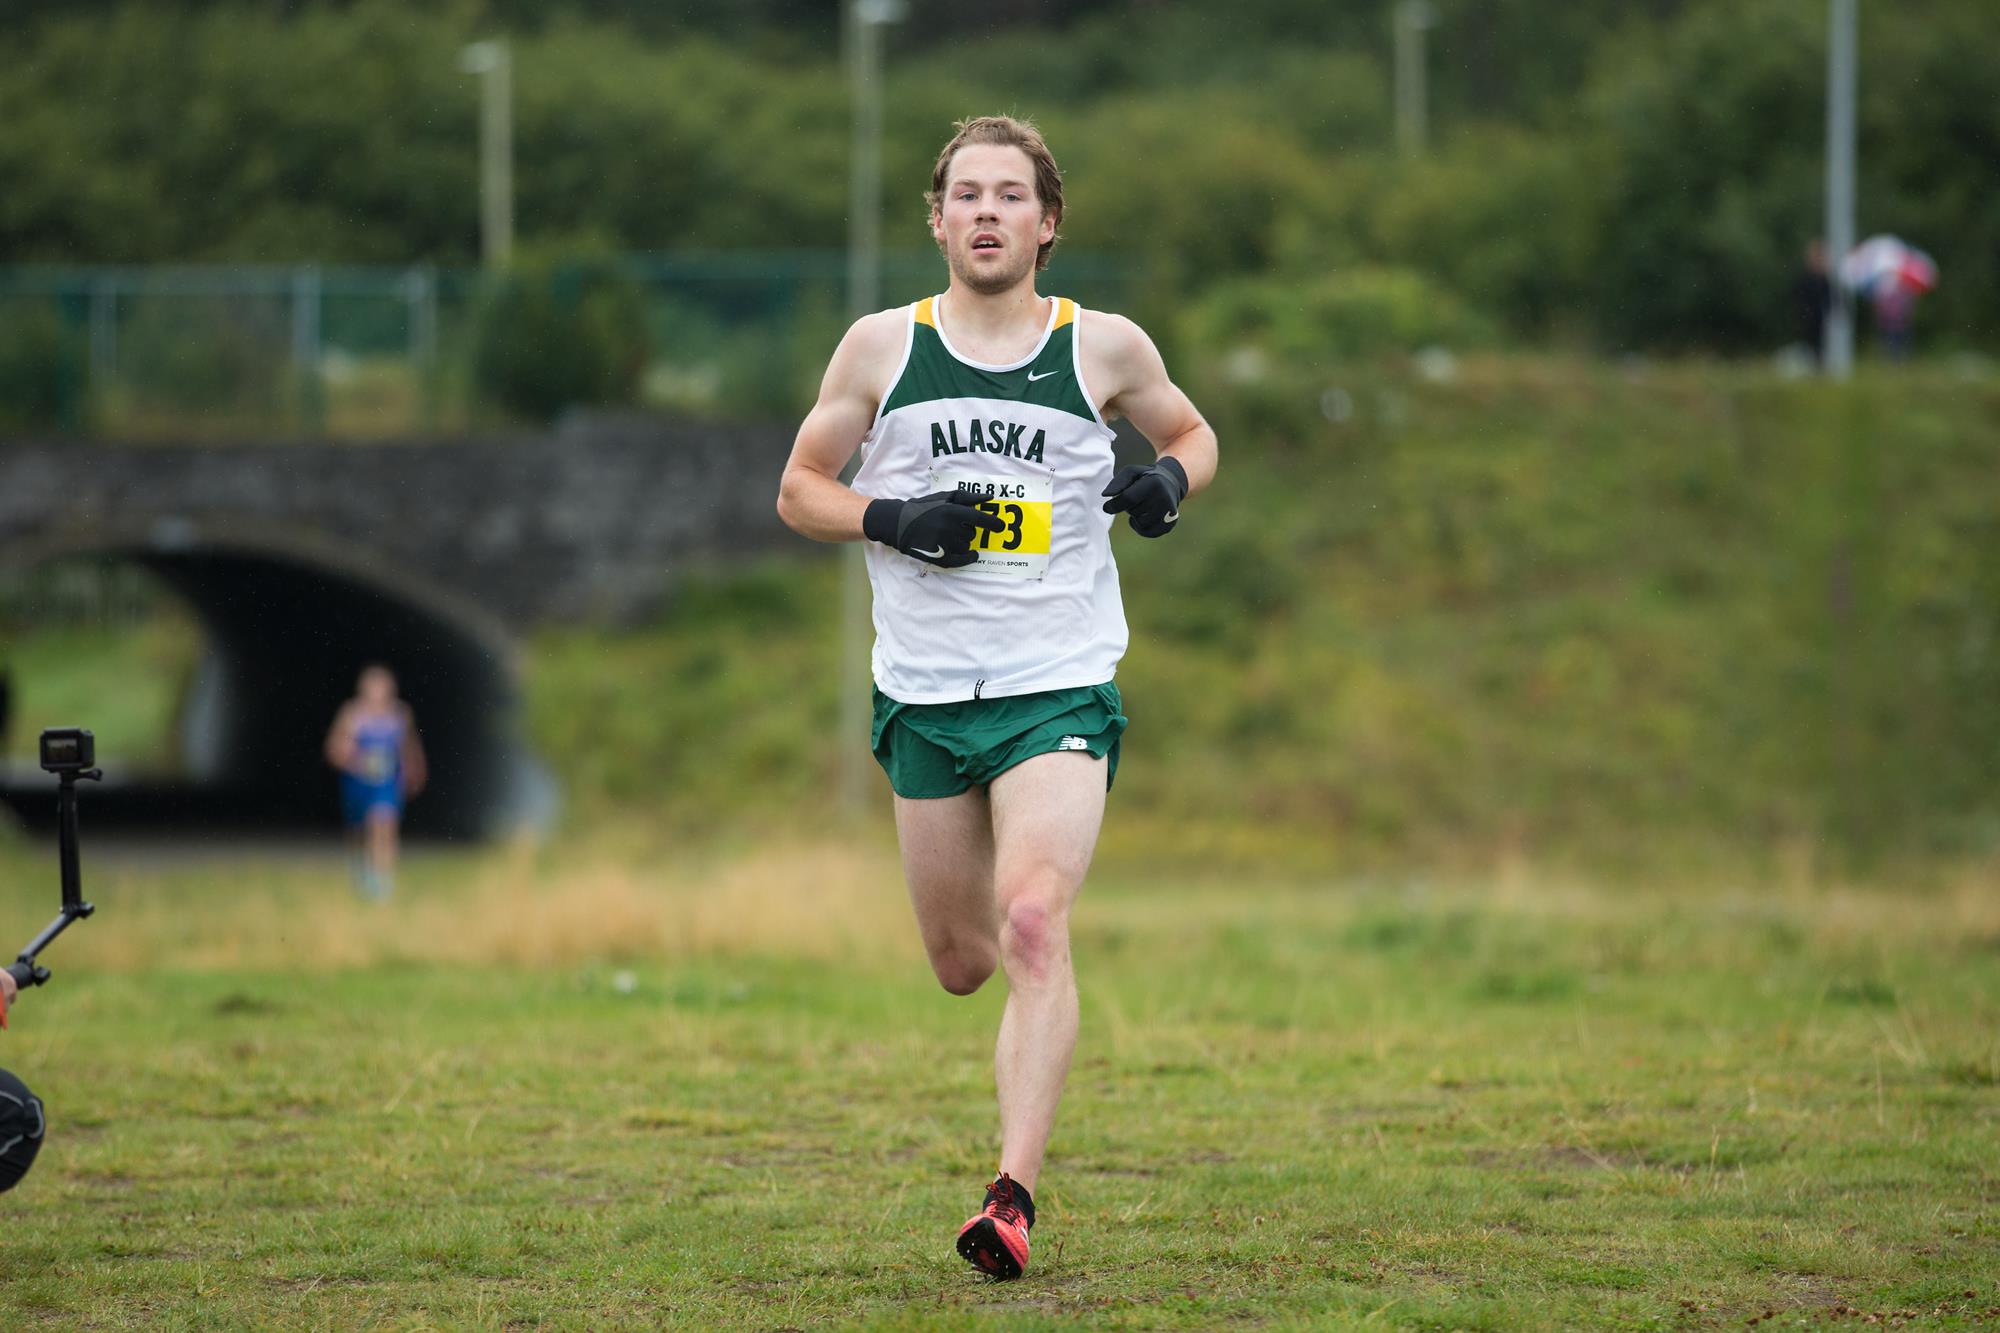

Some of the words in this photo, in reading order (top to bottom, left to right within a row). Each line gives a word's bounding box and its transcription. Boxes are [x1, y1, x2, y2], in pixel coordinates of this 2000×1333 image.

[930, 419, 1046, 464] ALASKA
[958, 481, 981, 494] BIG
[986, 483, 995, 495] 8
[999, 484, 1025, 498] X-C
